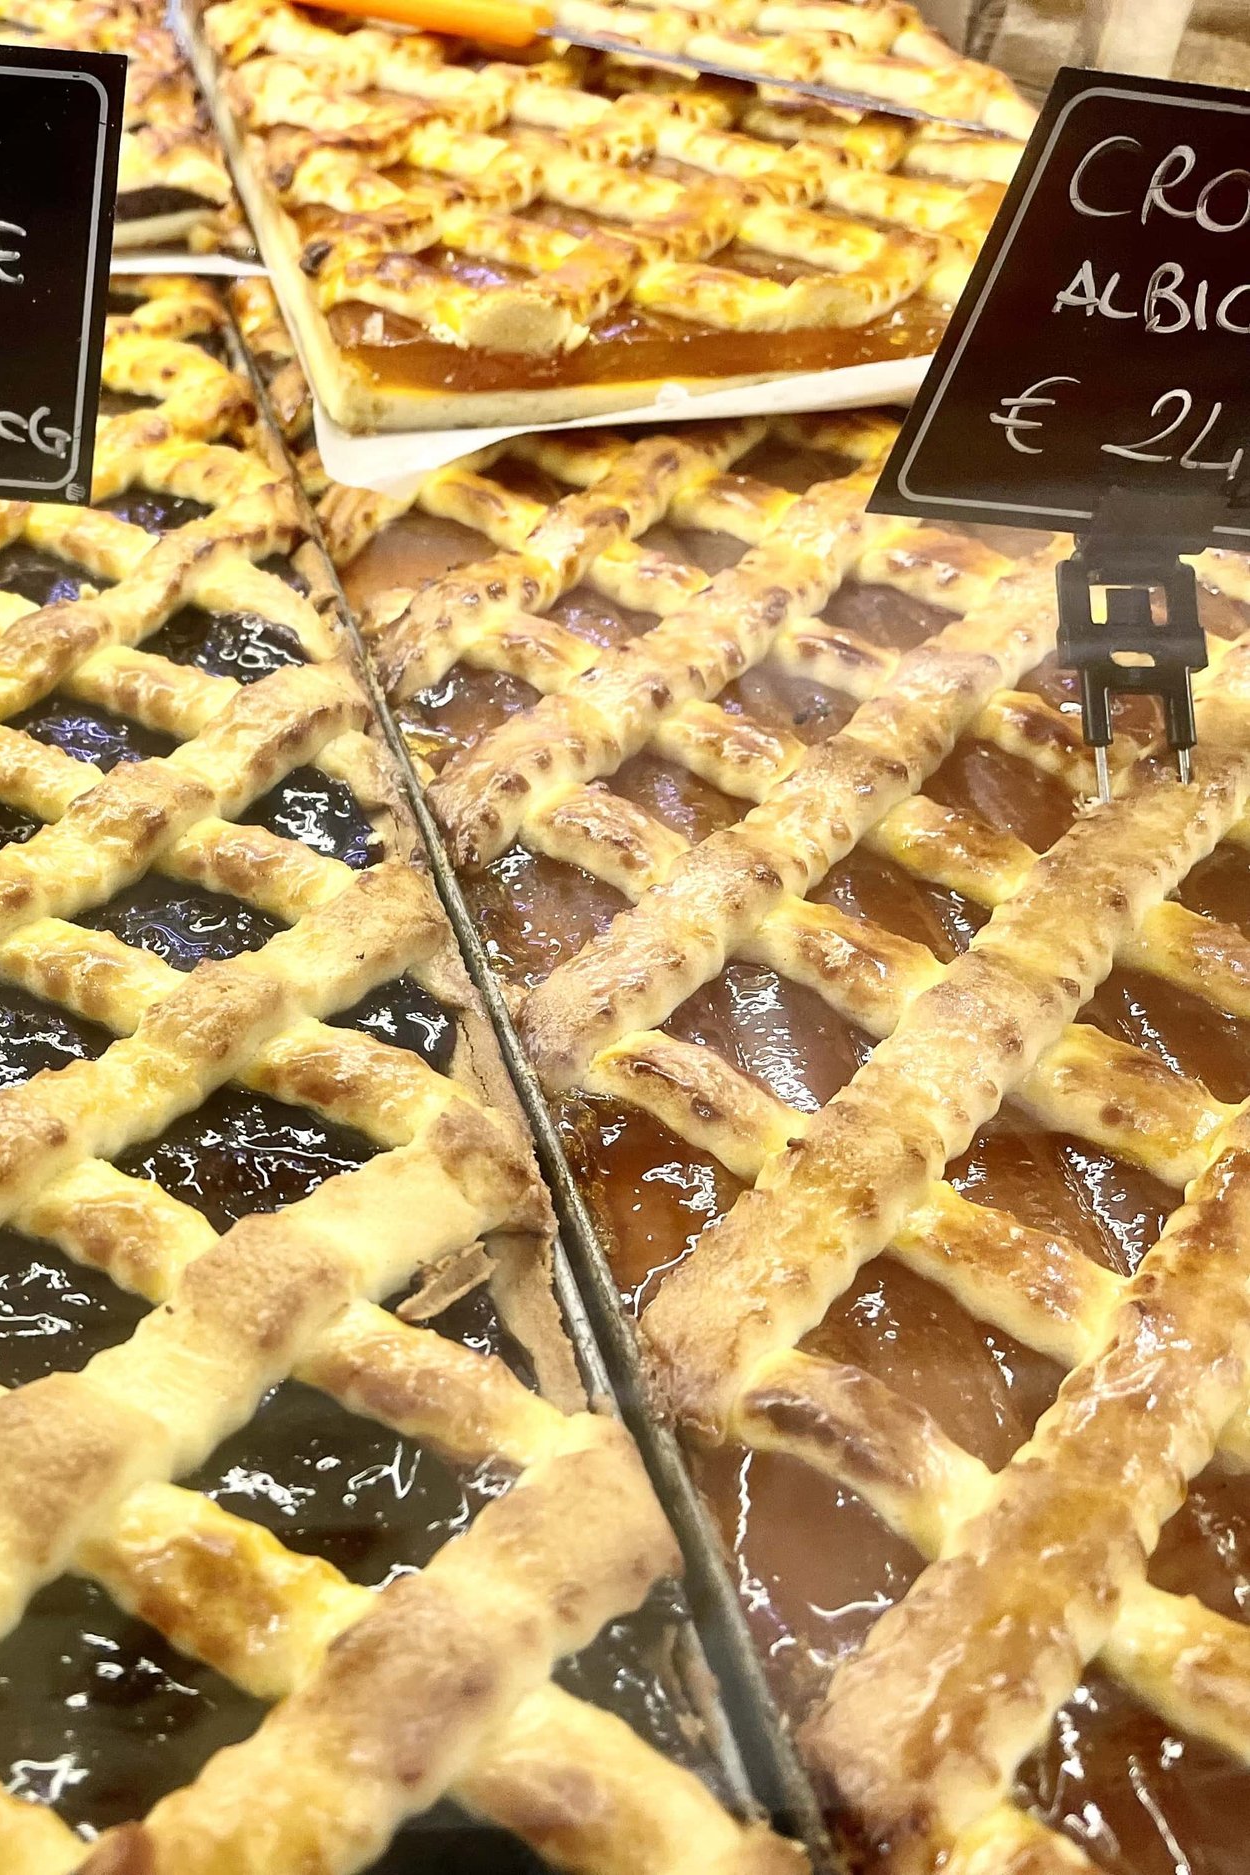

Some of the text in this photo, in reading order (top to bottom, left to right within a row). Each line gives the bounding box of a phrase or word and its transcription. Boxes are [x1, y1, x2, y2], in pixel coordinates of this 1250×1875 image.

[1069, 135, 1250, 233] CRO
[1052, 259, 1250, 333] ALBIC
[989, 376, 1081, 454] €
